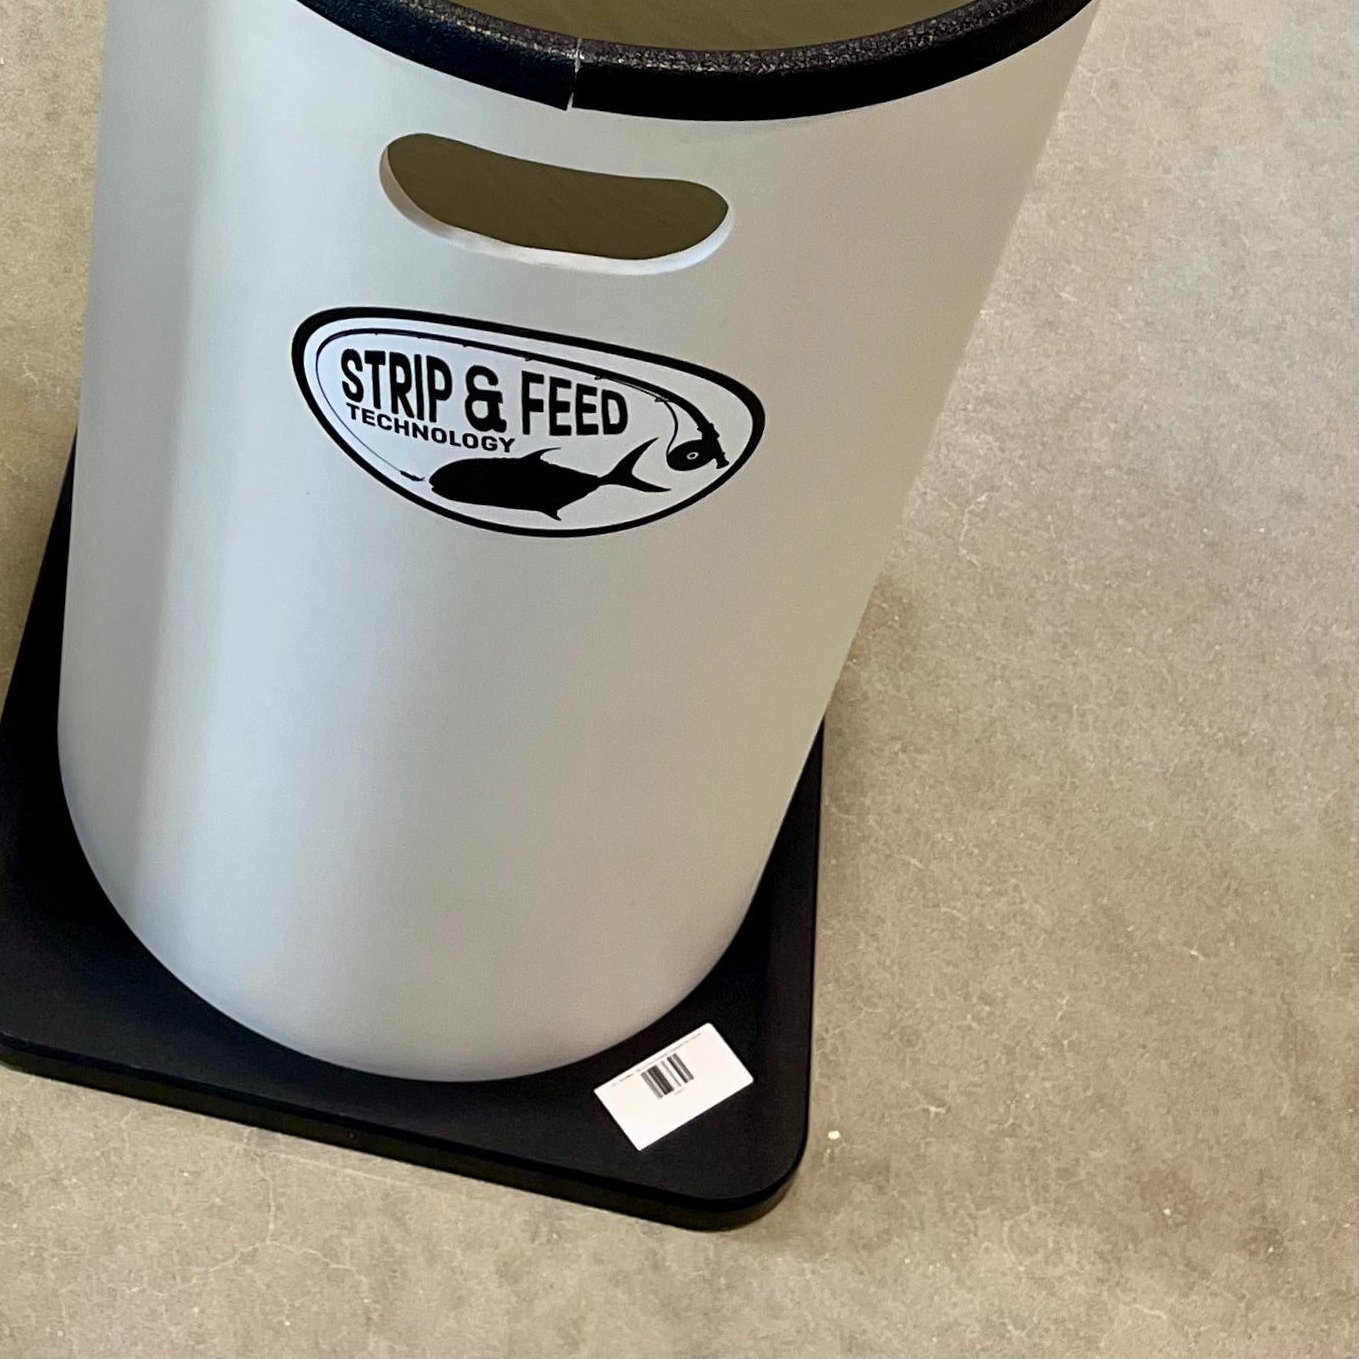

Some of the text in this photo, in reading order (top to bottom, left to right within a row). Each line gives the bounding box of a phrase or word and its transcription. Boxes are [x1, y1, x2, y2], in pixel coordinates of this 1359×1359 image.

[341, 348, 629, 437] STRIP & FEED
[345, 402, 516, 453] TECHNOLOGY
